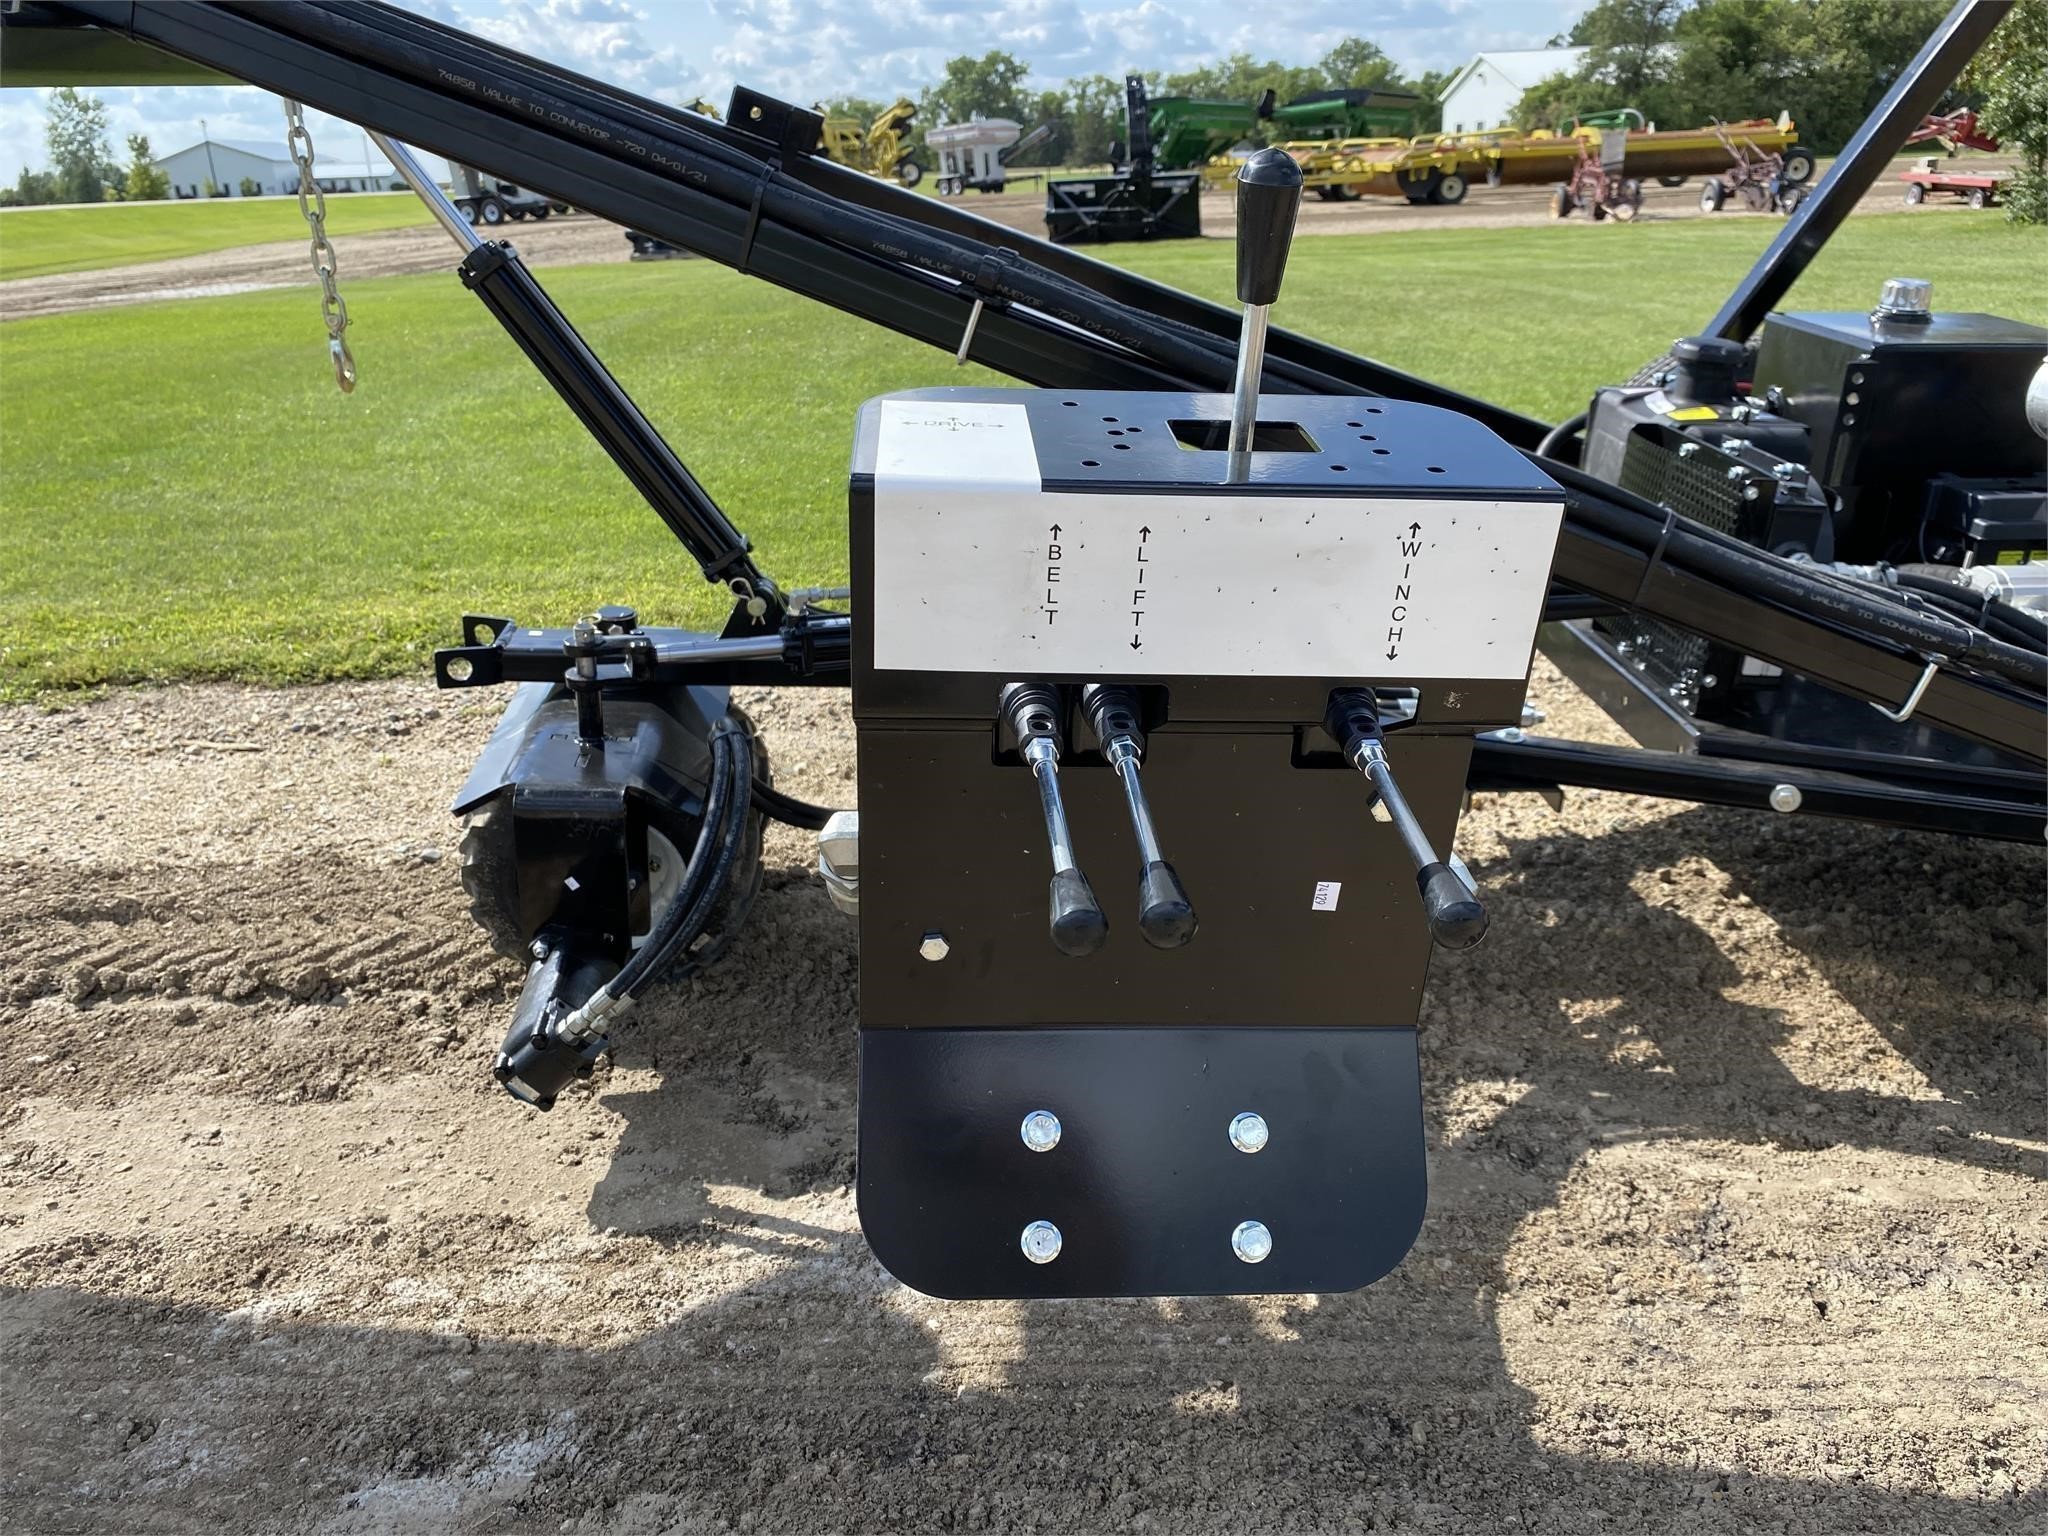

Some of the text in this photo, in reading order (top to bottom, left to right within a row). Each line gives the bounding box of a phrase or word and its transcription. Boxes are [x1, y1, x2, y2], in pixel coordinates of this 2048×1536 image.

[482, 86, 520, 108] VALVE
[528, 103, 544, 116] TO
[550, 111, 611, 142] CONVEYOR
[651, 153, 708, 184] 04/01/21
[960, 269, 976, 281] TO
[924, 420, 984, 428] DRIVE
[1045, 544, 1062, 625] BELT
[1131, 546, 1149, 626] LIFT
[1387, 541, 1422, 642] WINCH
[1857, 609, 1873, 621] TO
